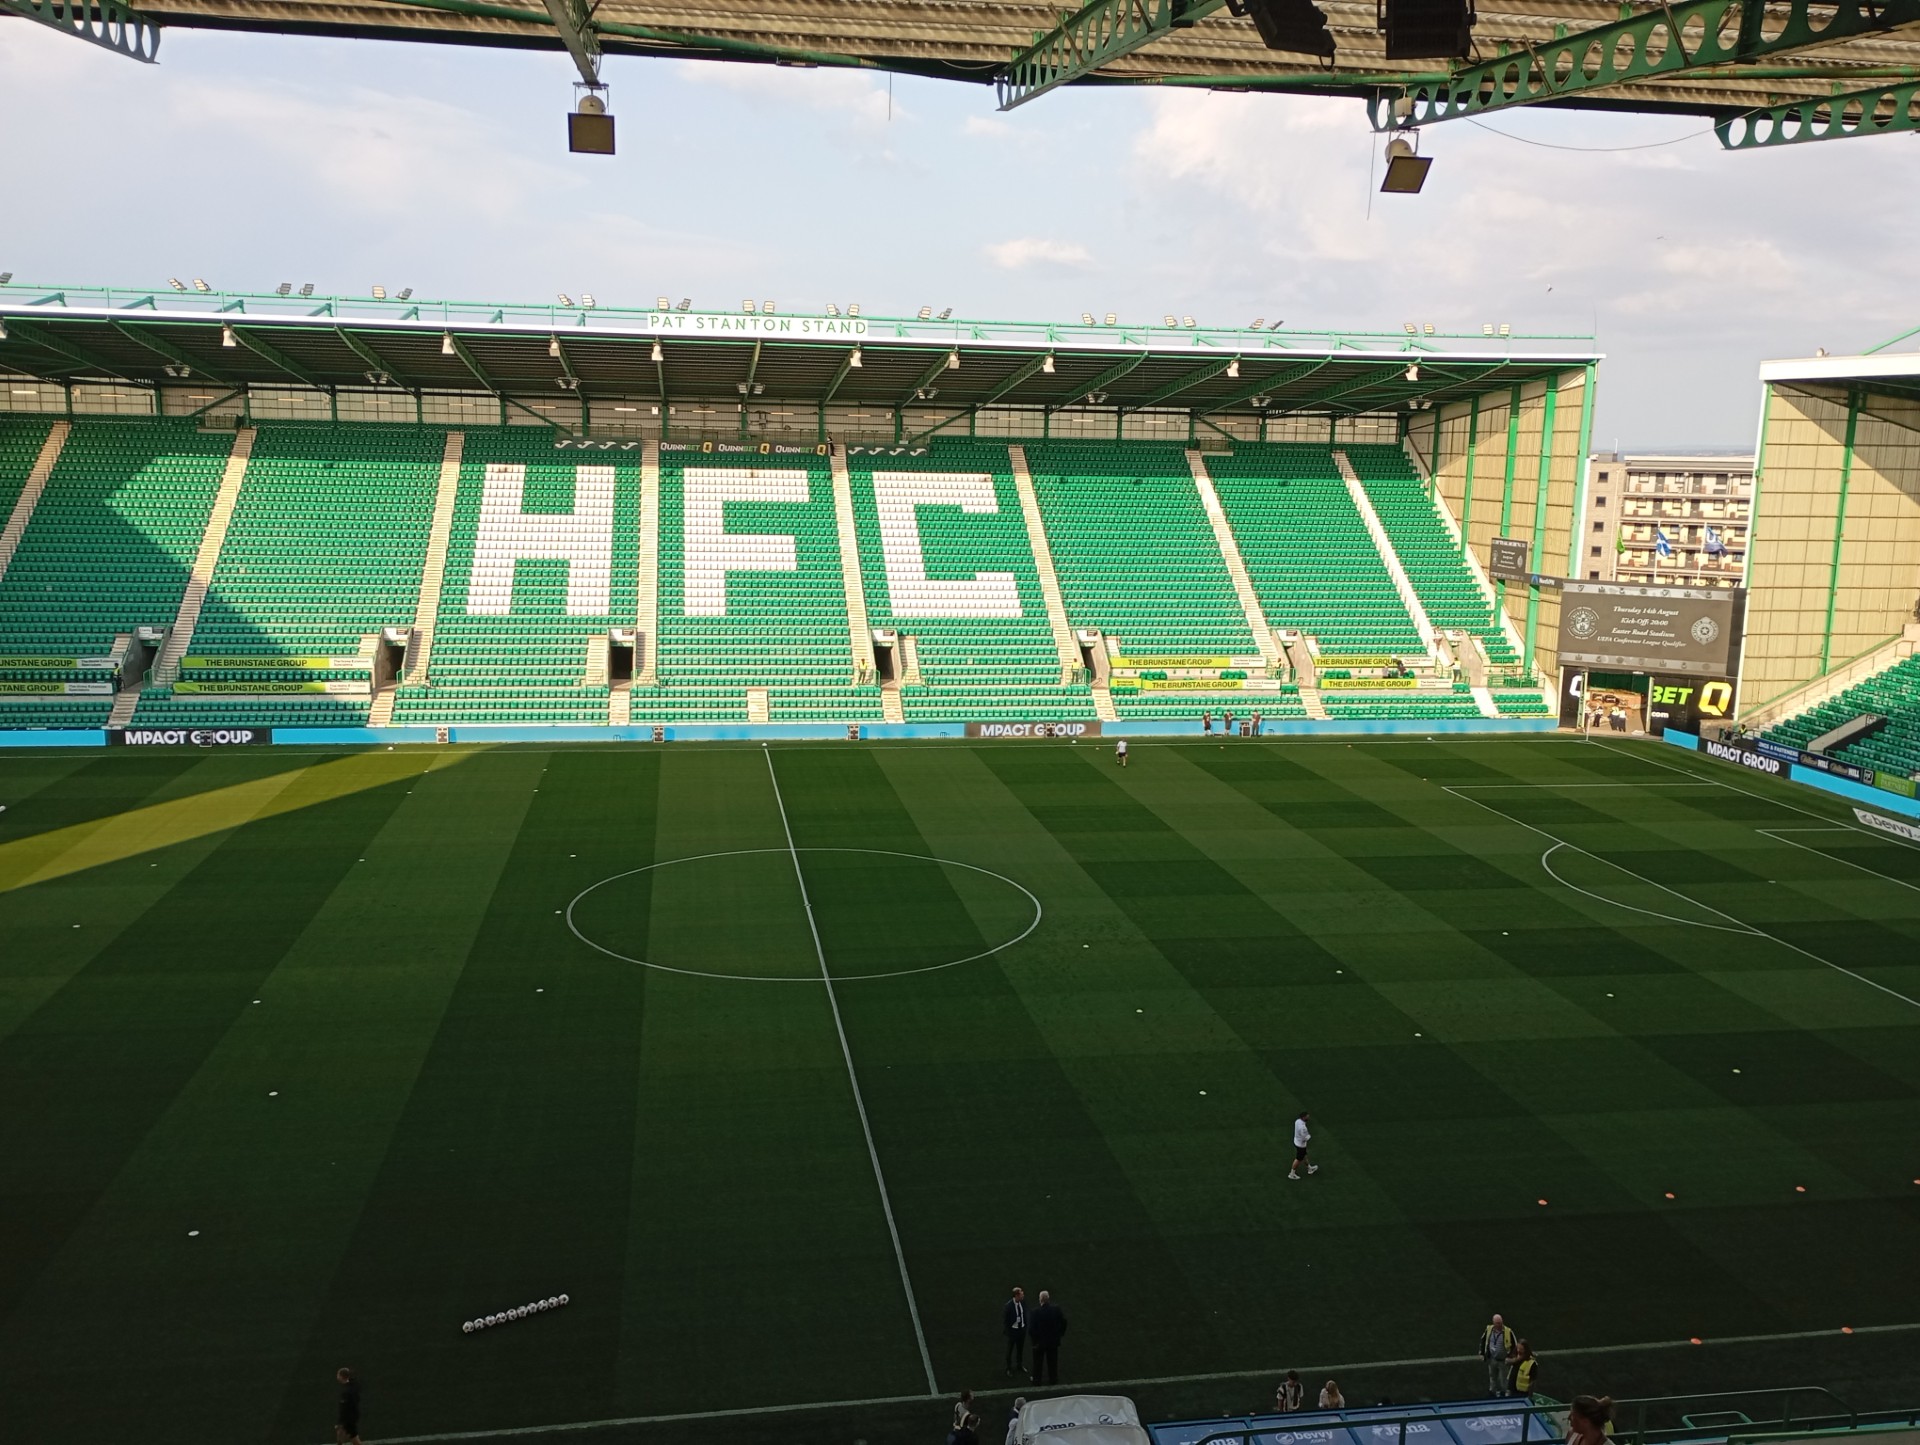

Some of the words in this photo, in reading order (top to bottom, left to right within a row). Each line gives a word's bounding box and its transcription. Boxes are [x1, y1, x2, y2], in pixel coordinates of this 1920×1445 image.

[650, 315, 686, 329] PAT
[696, 316, 791, 332] STANTON
[802, 319, 867, 334] STAND
[660, 441, 701, 452] QUINNBET
[718, 442, 758, 453] QUINNBET
[775, 444, 815, 454] QUINNBET
[466, 463, 1023, 618] HFC
[1613, 606, 1641, 615] Thursday
[1657, 609, 1679, 617] August
[1611, 627, 1631, 635] Easter
[1661, 640, 1687, 648] Qualifier
[41, 659, 72, 667] GROUP
[205, 659, 222, 667] THE
[223, 659, 276, 667] BRUNSTANE
[277, 659, 308, 667] GROUP
[1316, 658, 1330, 666] THE
[1330, 658, 1373, 666] BRUNSTANE
[1373, 658, 1398, 666] GROUP
[27, 684, 60, 692] GROUP
[198, 684, 216, 692] THE
[216, 684, 270, 692] BRUNSTANE
[271, 684, 303, 692] GROUP
[1386, 680, 1411, 688] GROUP
[980, 724, 1033, 737] MPACT
[1034, 723, 1085, 736] GOUP
[125, 730, 186, 745] MPACT
[1707, 741, 1742, 762] MPACT
[1742, 753, 1780, 774] GROUP
[1482, 1417, 1522, 1426] bevvy
[1293, 1431, 1333, 1440] bevvy
